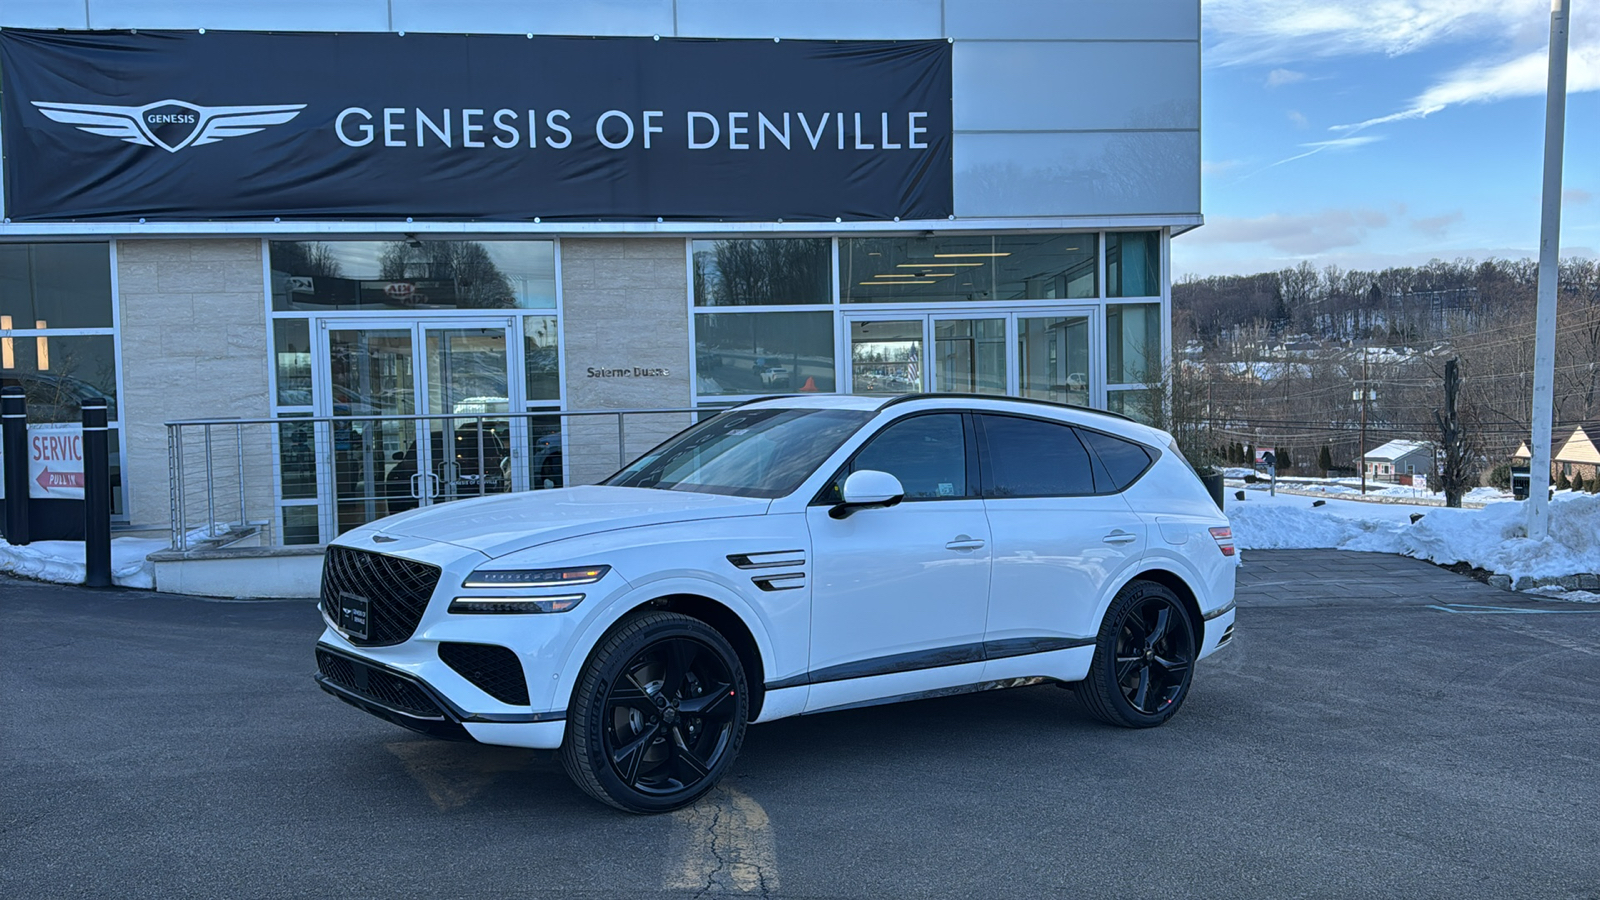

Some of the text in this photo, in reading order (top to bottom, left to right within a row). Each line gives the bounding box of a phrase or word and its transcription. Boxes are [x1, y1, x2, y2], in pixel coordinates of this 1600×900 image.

[147, 114, 195, 124] GENESIS
[335, 107, 928, 151] GENESIS OF DENVILLE
[33, 435, 83, 461] SERVIC
[49, 474, 67, 485] PULL
[590, 680, 607, 751] MICHELIN
